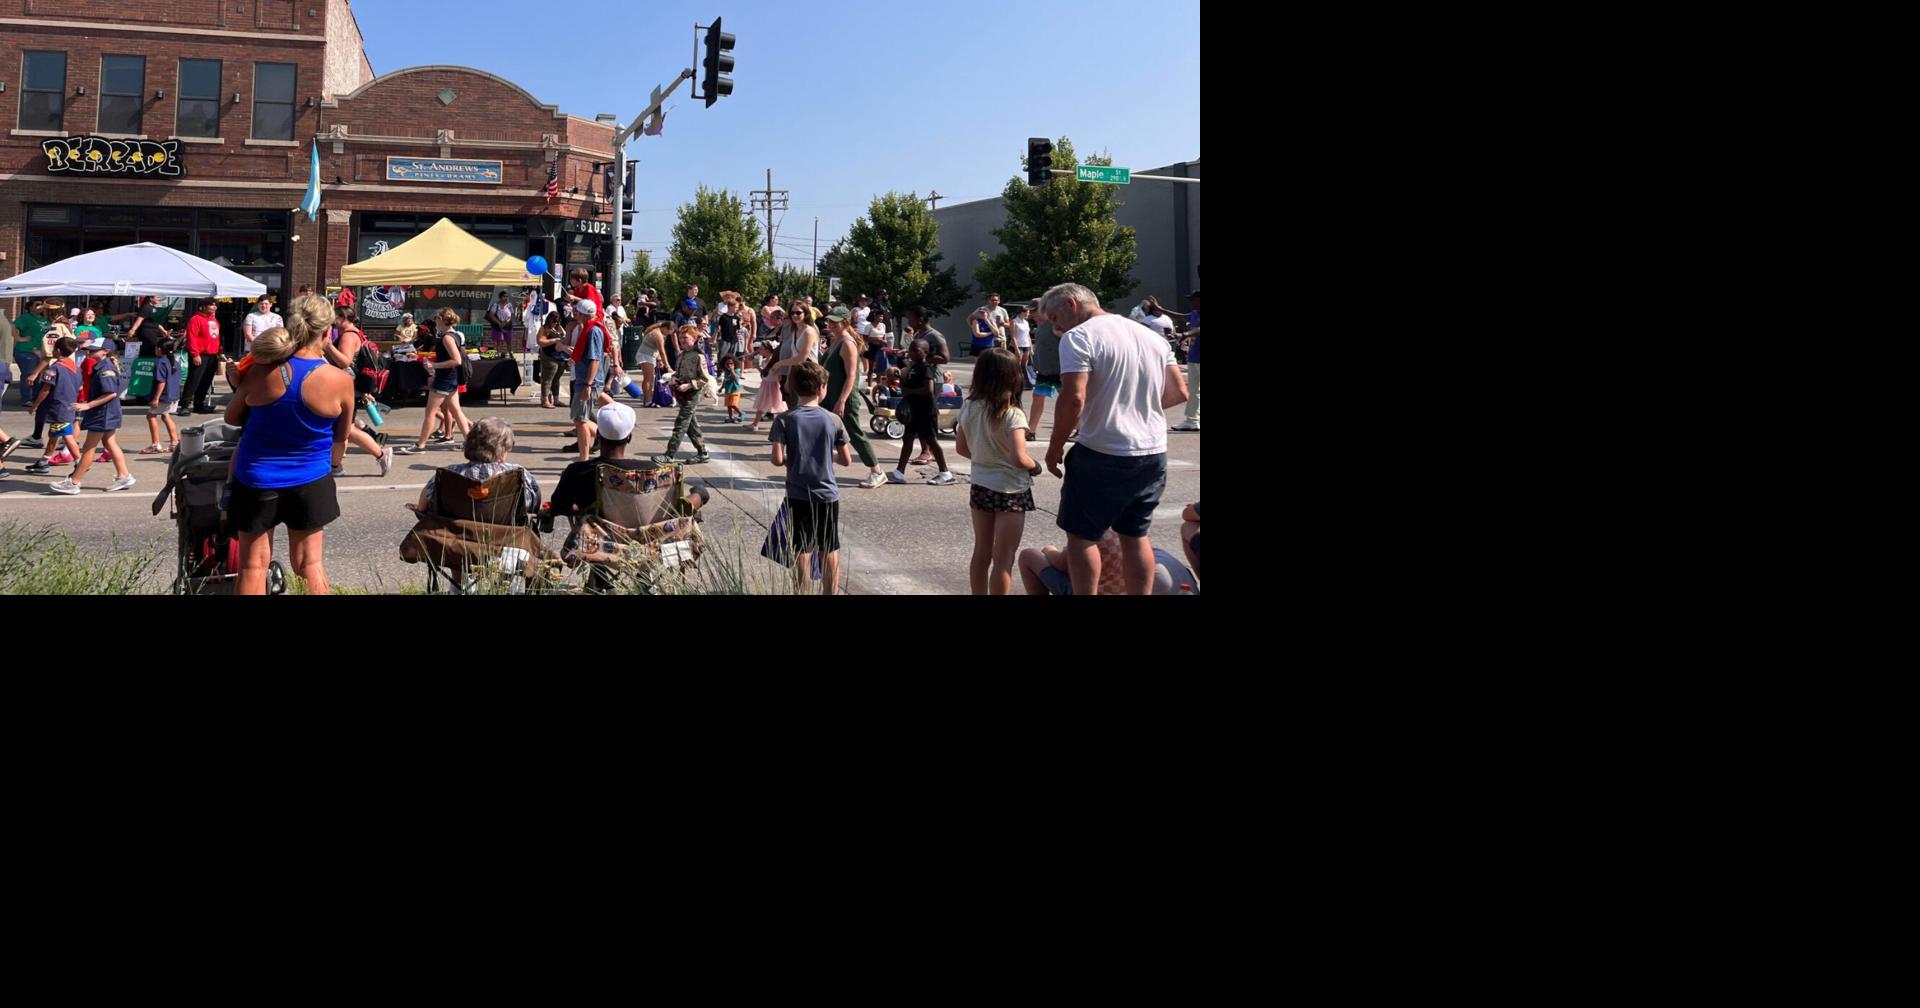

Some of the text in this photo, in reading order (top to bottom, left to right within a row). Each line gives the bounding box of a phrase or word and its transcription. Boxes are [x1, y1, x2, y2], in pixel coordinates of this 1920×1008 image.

[42, 136, 180, 176] BEERCADE
[431, 162, 479, 172] ANDREWS
[1080, 168, 1104, 180] Maple
[580, 219, 607, 235] 6102
[407, 289, 493, 299] HE MOVEMENT
